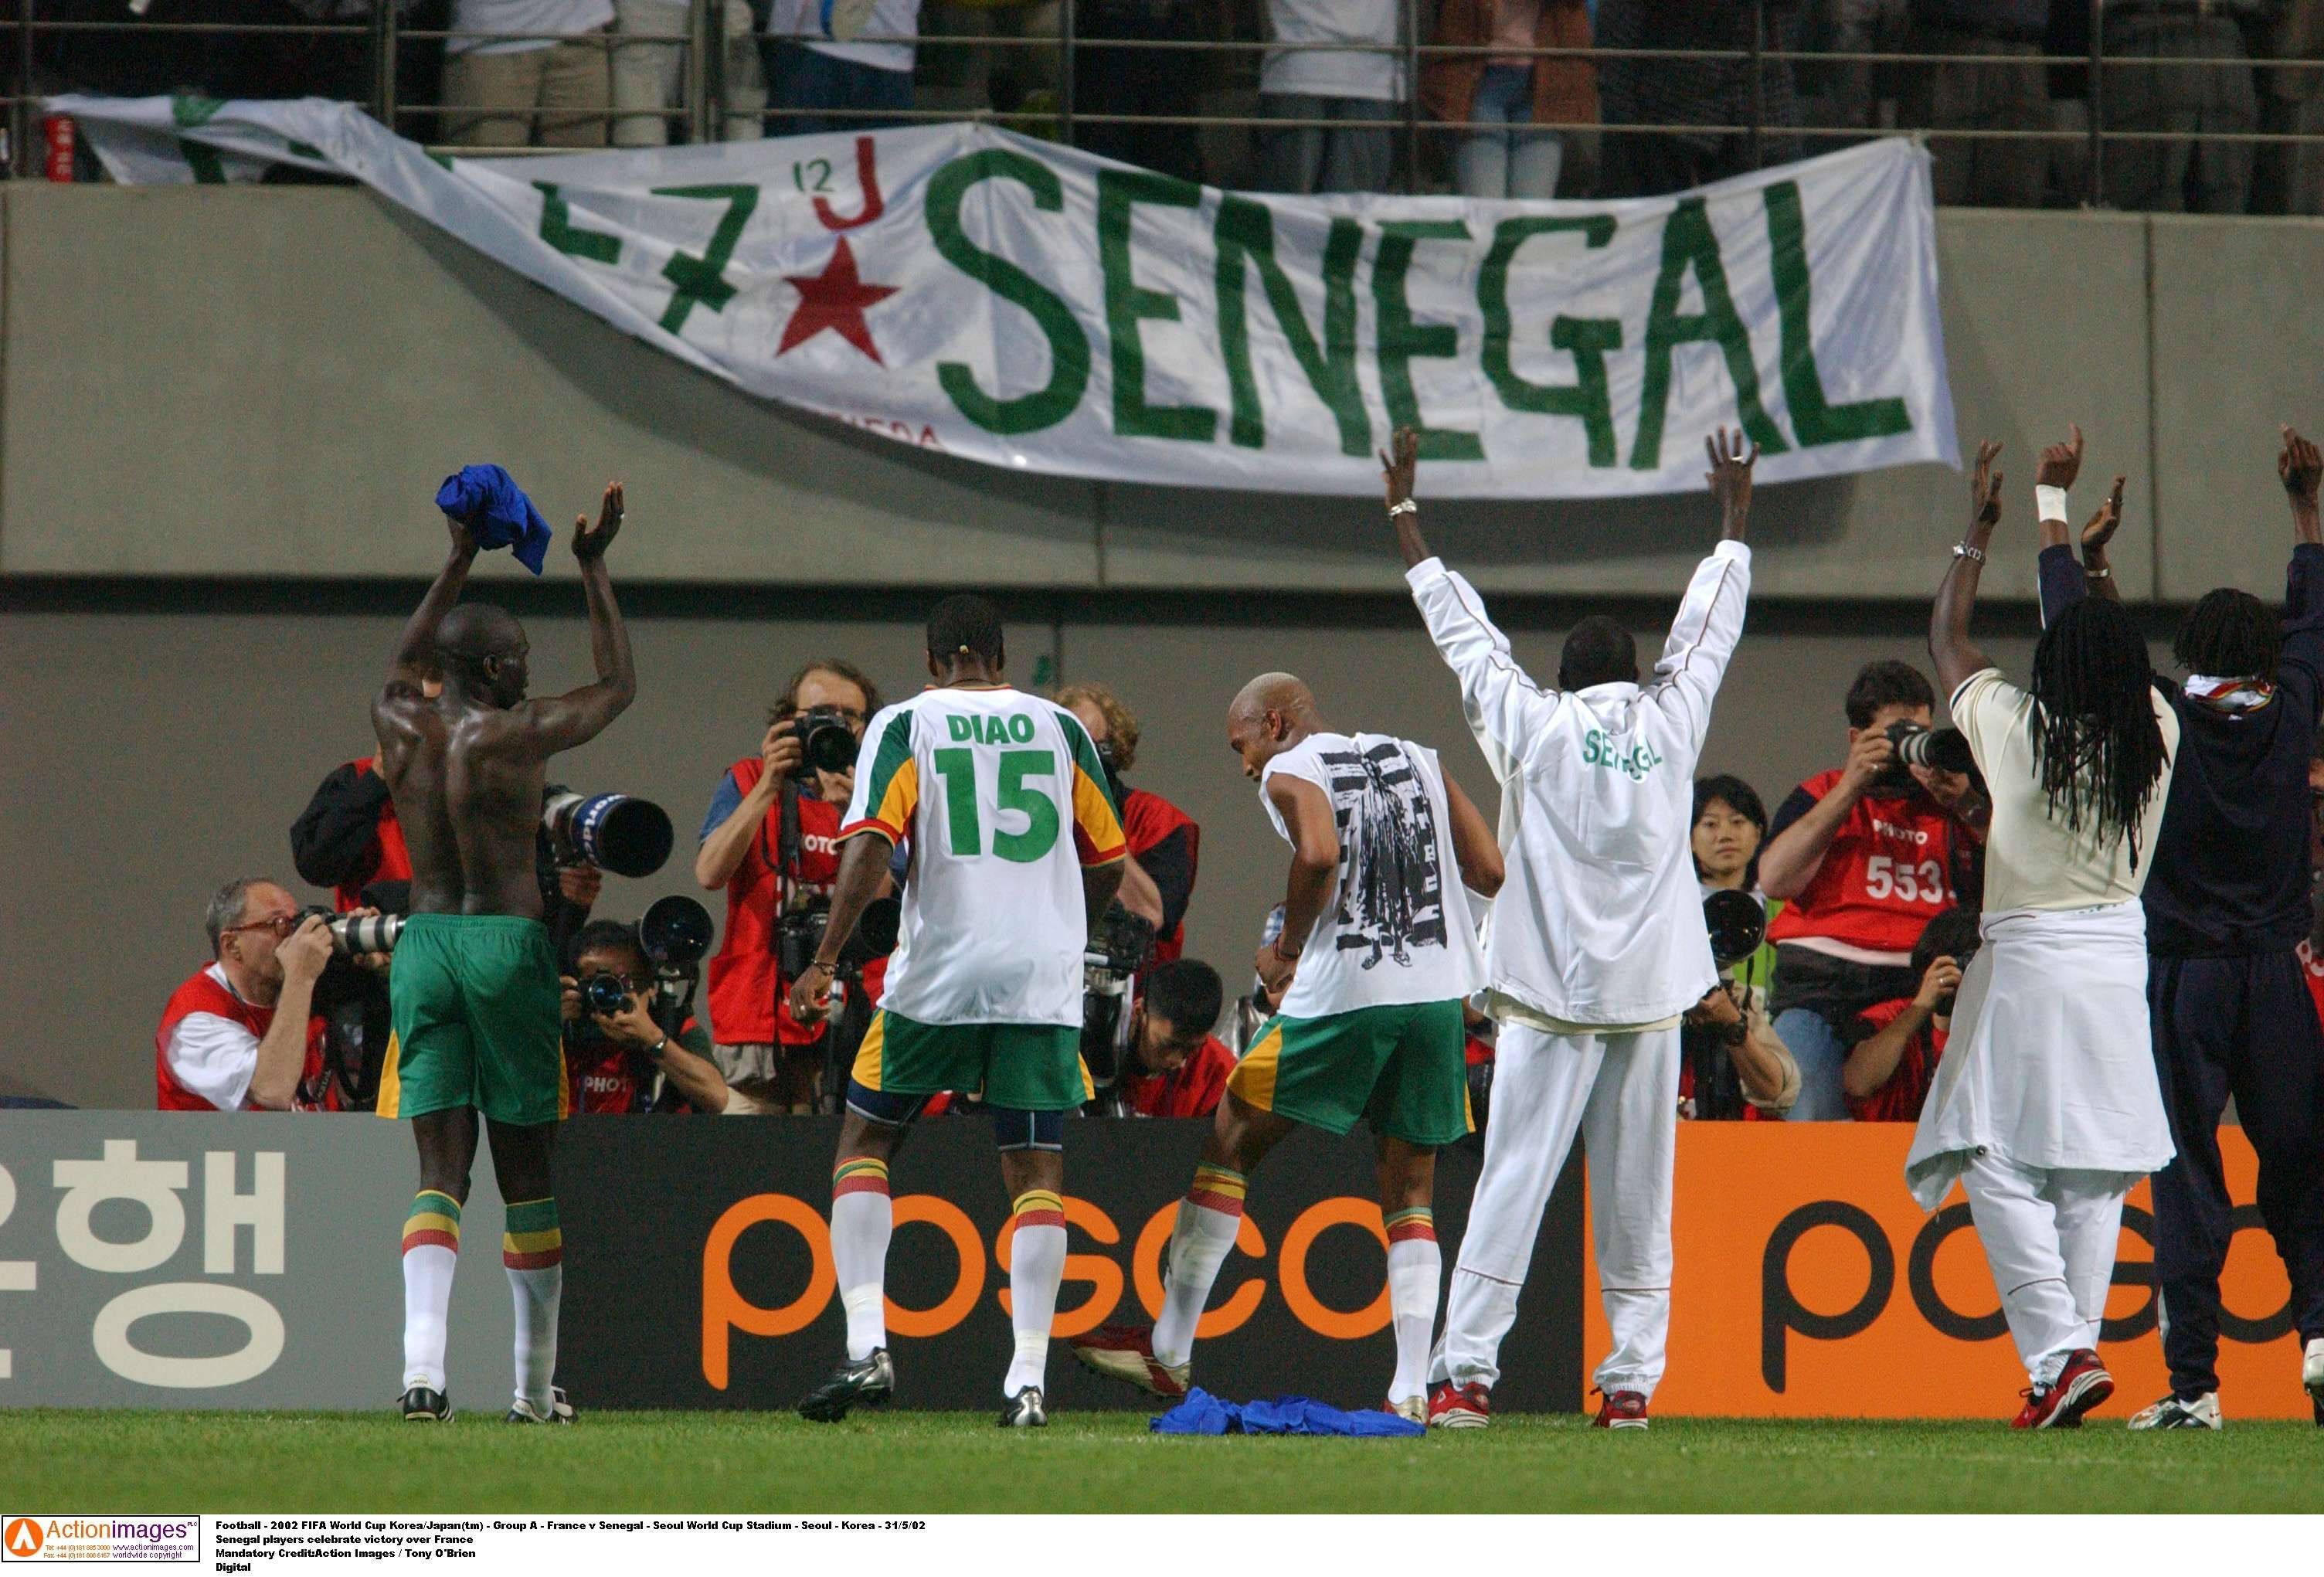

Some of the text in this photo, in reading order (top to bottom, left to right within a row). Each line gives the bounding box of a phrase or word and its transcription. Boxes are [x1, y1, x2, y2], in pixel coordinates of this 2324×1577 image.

[925, 149, 1912, 469] SENEGAL
[945, 714, 1035, 744] DIAO
[933, 748, 1059, 863] 15
[1866, 855, 1944, 904] 553
[0, 1139, 285, 1388] 행
